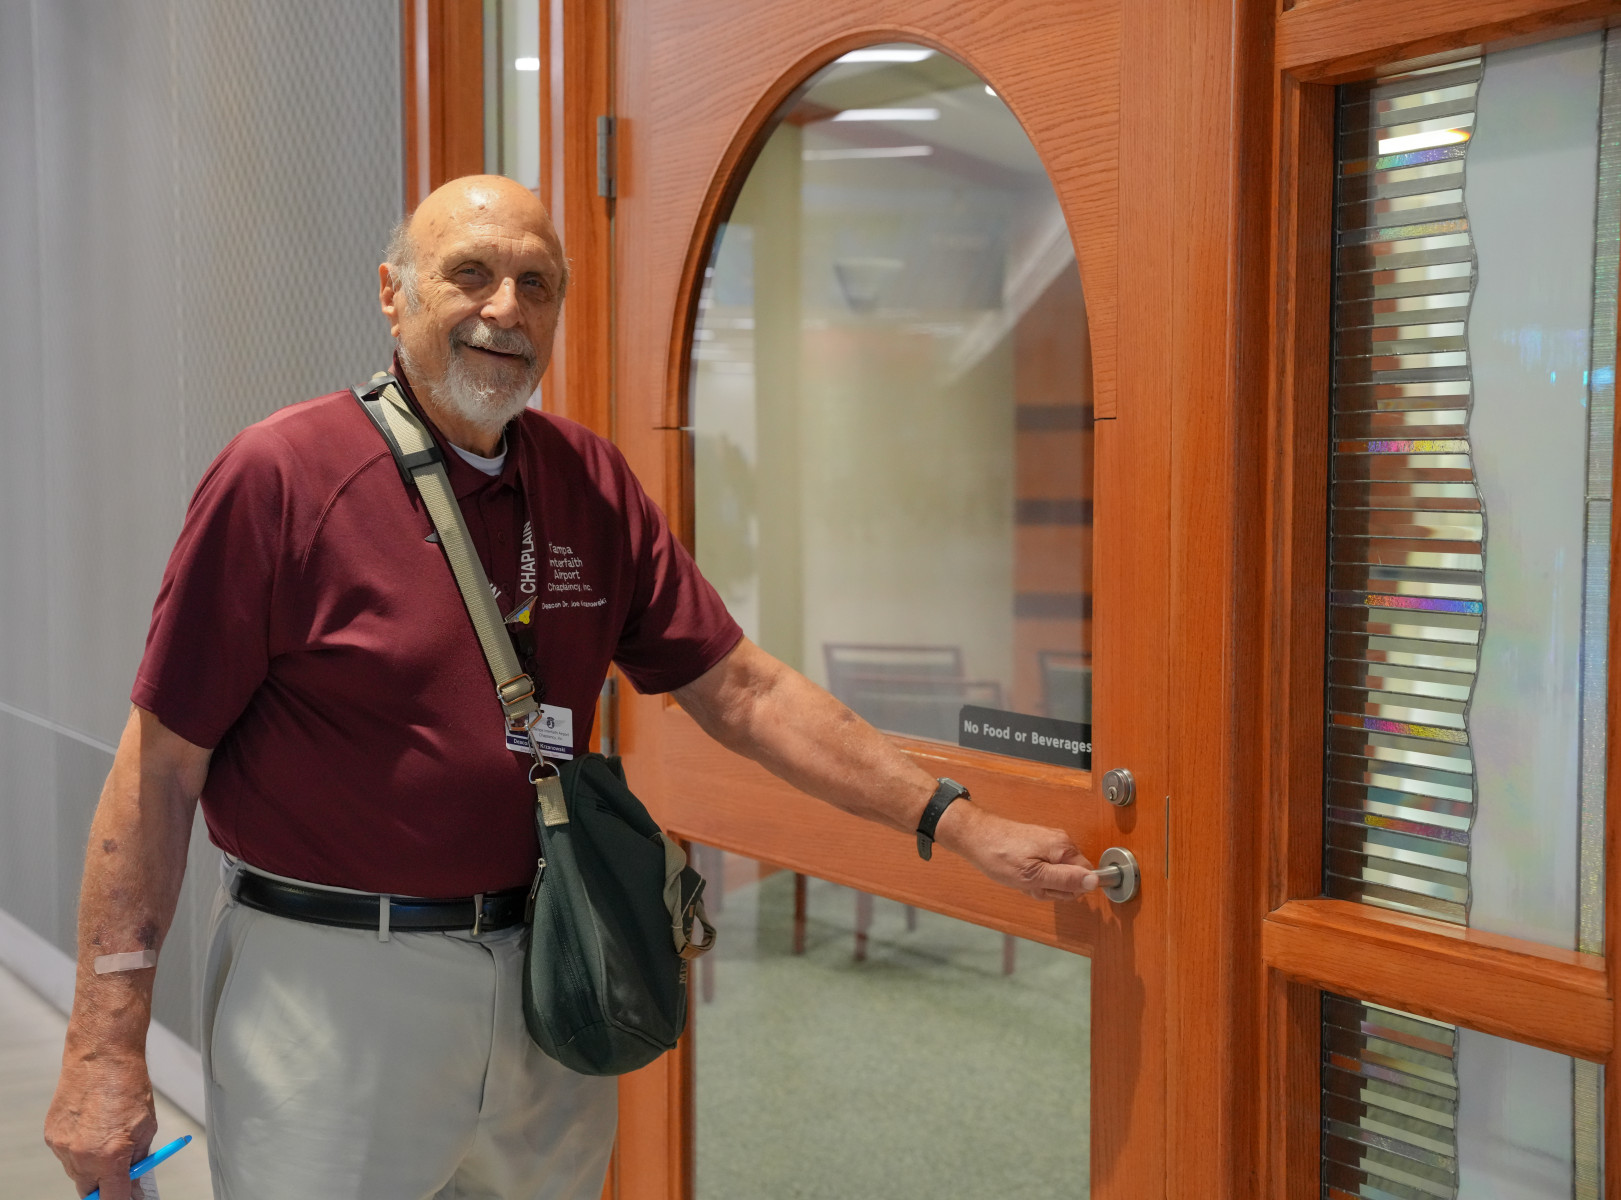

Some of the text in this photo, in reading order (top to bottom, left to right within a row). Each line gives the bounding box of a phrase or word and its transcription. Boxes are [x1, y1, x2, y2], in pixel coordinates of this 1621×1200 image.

[520, 520, 536, 594] CHAPLAIN
[554, 569, 580, 581] Airport
[964, 720, 1092, 754] No Food or Beverages
